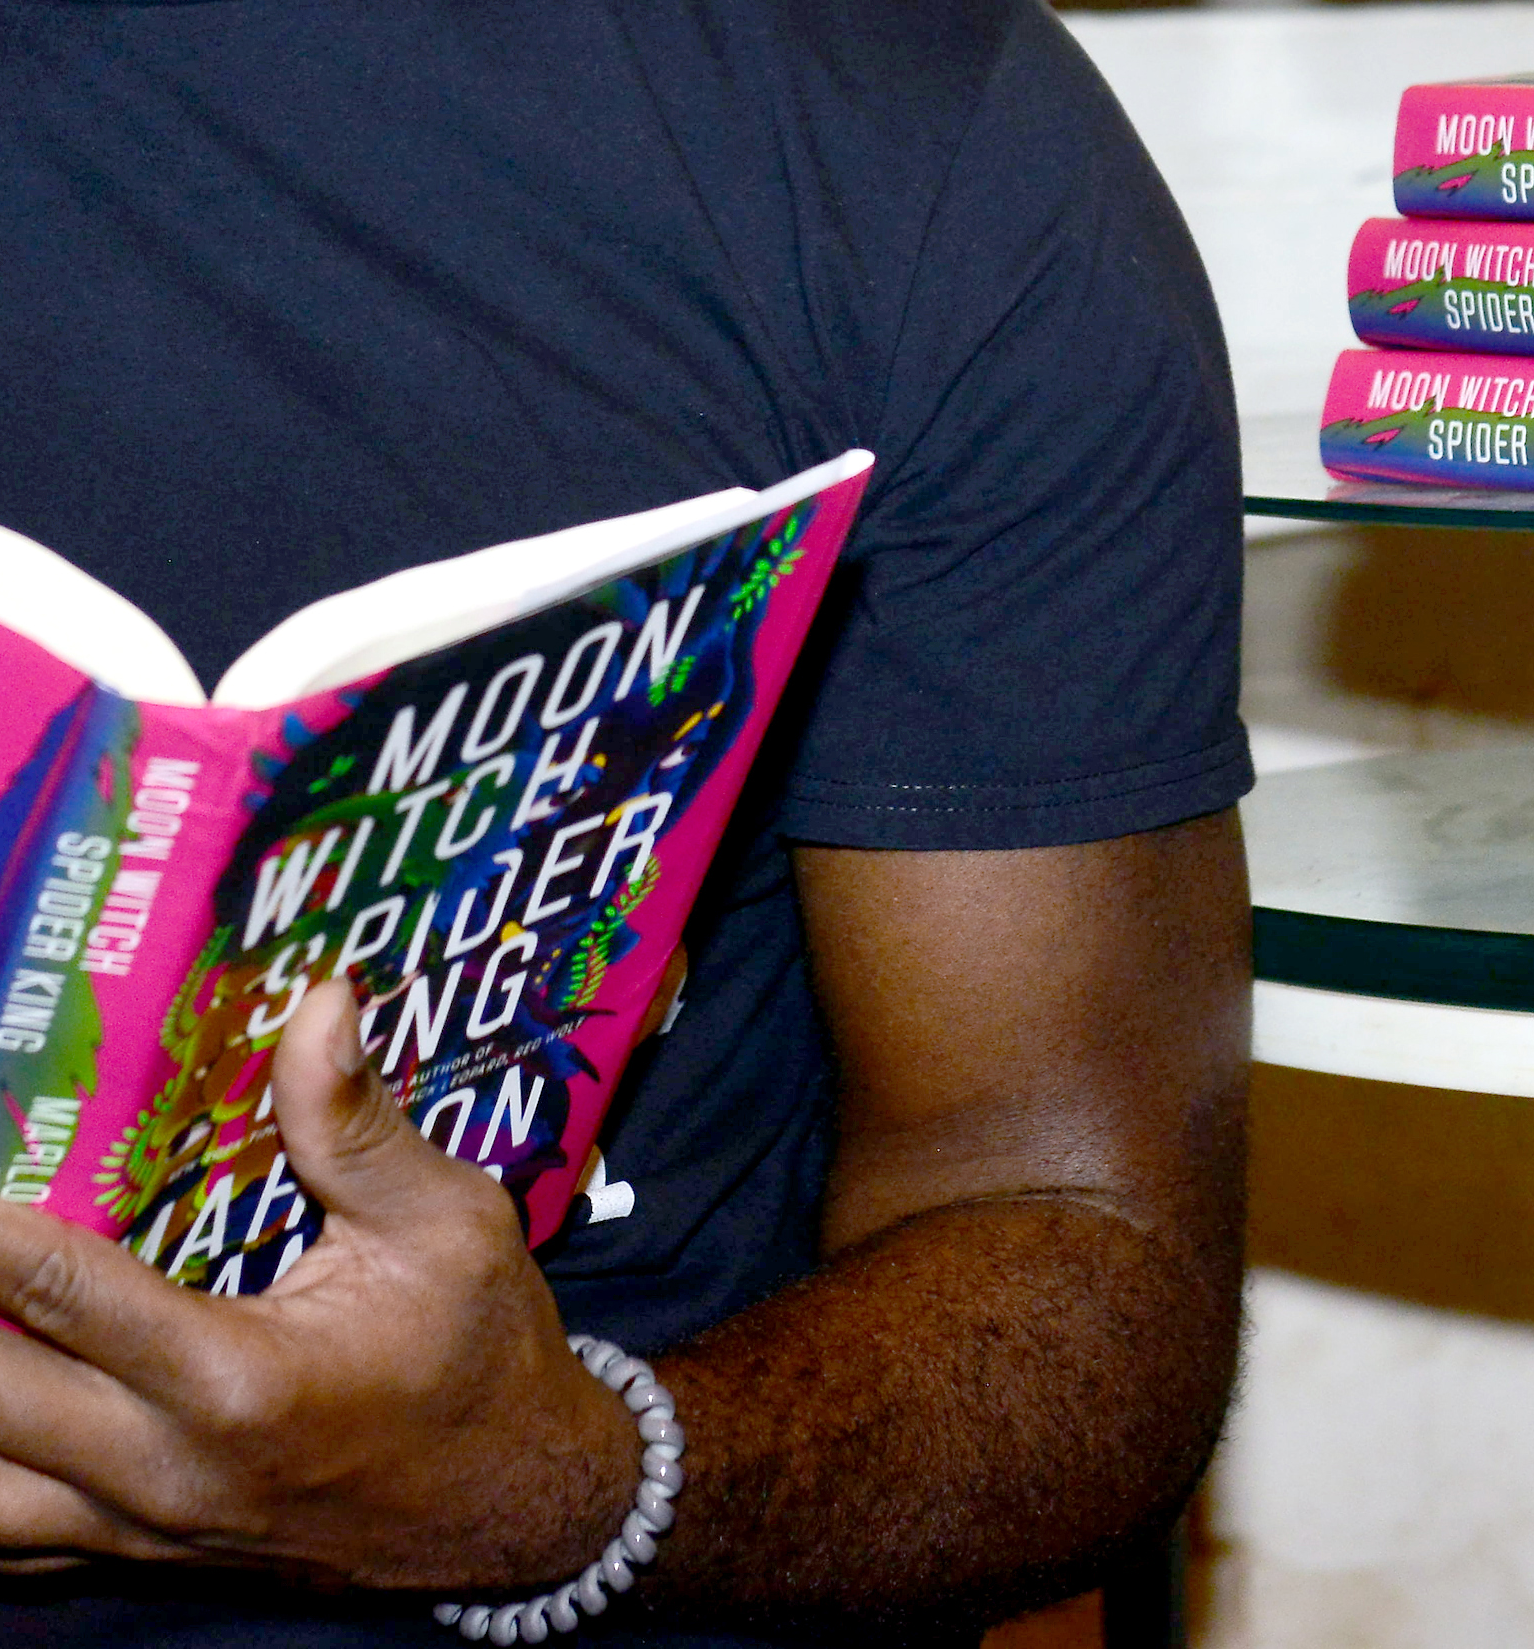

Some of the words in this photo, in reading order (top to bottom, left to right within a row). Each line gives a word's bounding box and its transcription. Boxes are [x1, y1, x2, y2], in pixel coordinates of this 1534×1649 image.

[1437, 114, 1514, 156] MOON
[1383, 239, 1457, 282] MOON
[1368, 369, 1451, 413] MOON
[1428, 419, 1528, 466] SPIDER
[366, 584, 706, 794] MOON
[118, 757, 201, 860] MOON
[241, 716, 600, 950] WITCH
[23, 832, 112, 962] SPIDER
[79, 870, 163, 976] WITCH
[246, 792, 672, 1040] SPIDER
[408, 1053, 469, 1088] AUTHOR
[476, 1042, 495, 1060] OF
[514, 1036, 543, 1061] RED
[545, 1016, 585, 1045] WOLF
